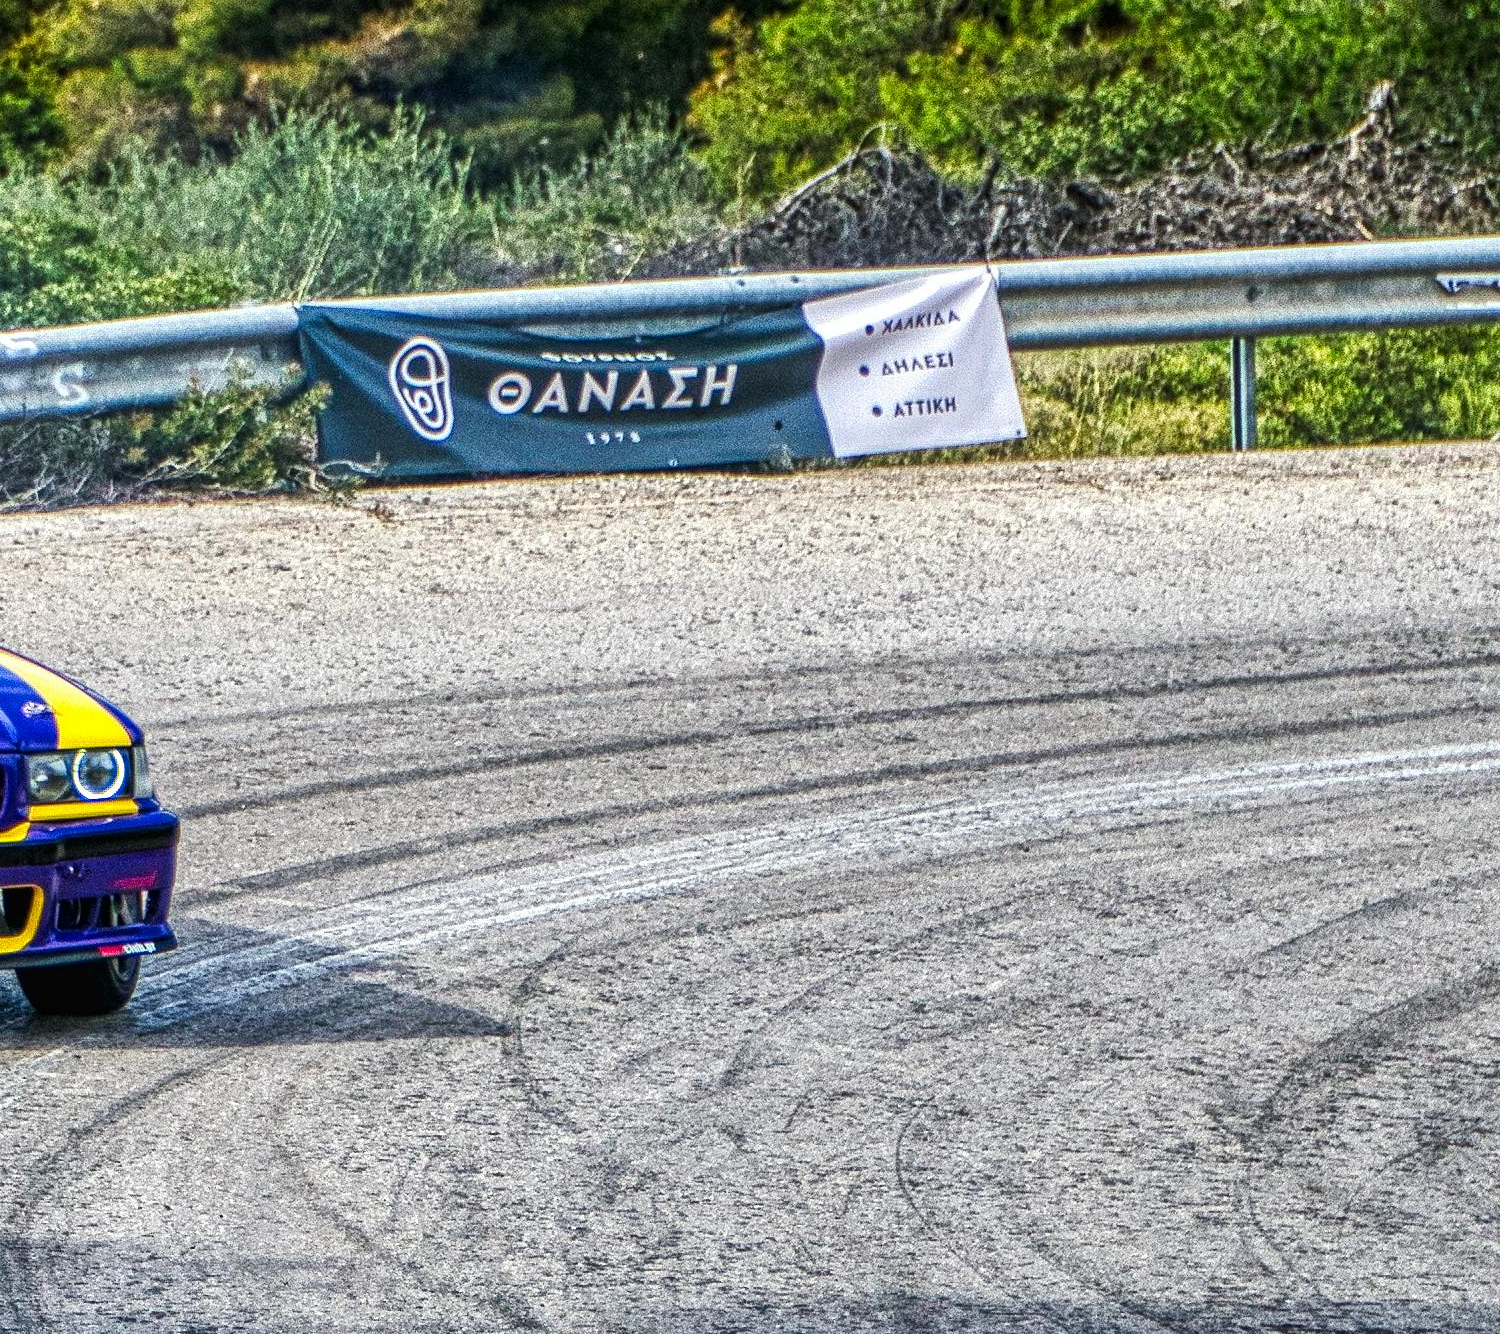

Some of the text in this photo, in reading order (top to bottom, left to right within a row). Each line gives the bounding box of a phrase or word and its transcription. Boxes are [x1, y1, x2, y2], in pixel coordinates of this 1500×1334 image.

[880, 352, 955, 377] ΔΗΛΕΣΙ
[488, 365, 738, 415] ΘΑΝΑΣΗ
[893, 395, 957, 418] ΑΤΤΙΚΗ
